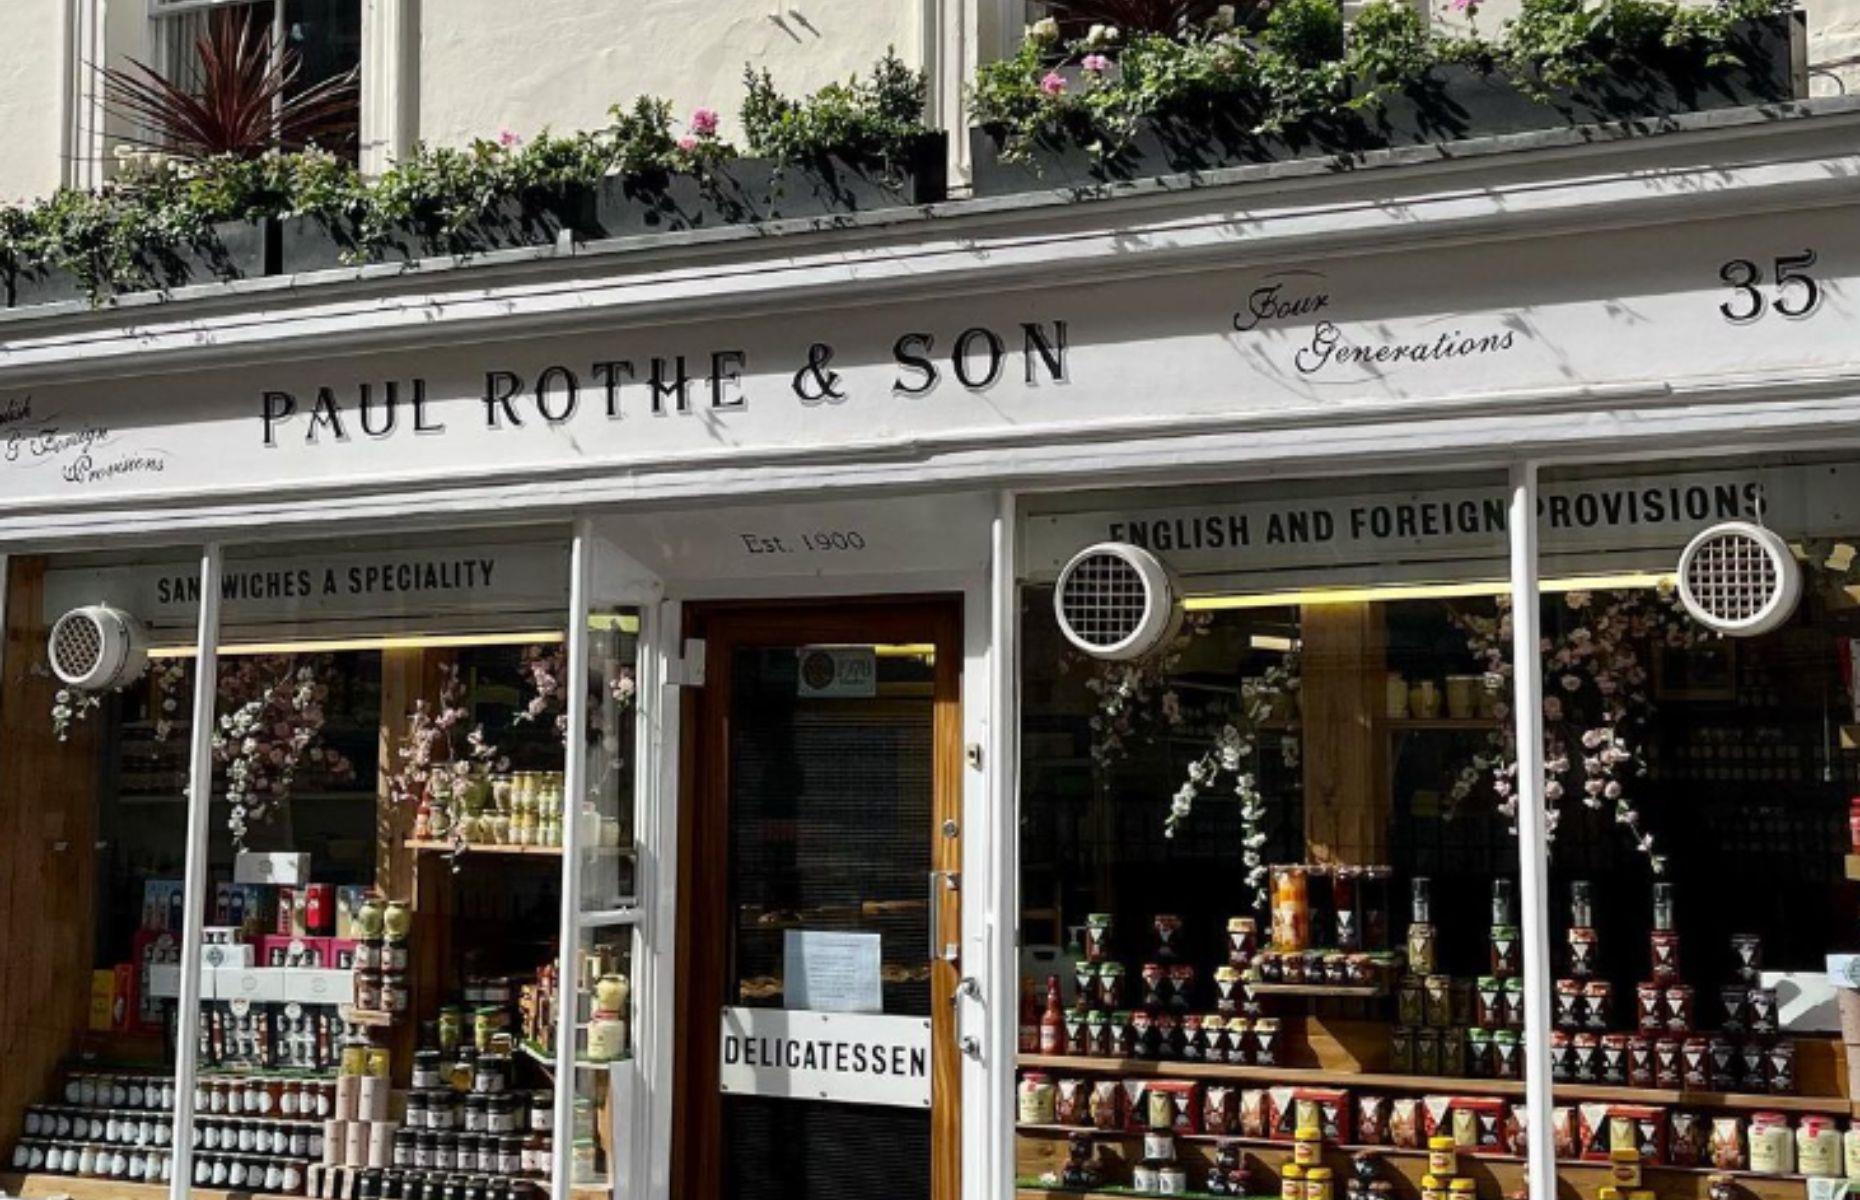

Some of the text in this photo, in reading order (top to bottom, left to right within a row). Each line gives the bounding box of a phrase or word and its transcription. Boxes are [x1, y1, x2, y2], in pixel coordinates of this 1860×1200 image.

[1233, 284, 1329, 331] Four
[1719, 248, 1826, 326] 35
[1295, 320, 1514, 374] Generations
[261, 319, 1072, 448] PAUL ROTHE & SON
[62, 452, 164, 483] Provisions
[801, 530, 866, 551] 1900
[1108, 514, 1249, 550] ENGLISH
[1266, 509, 1334, 544] AND
[1350, 497, 1506, 539] FOREIGN
[157, 558, 495, 604] SANWICHES A SPECIALITY
[724, 1035, 926, 1077] DELICATESSEN
